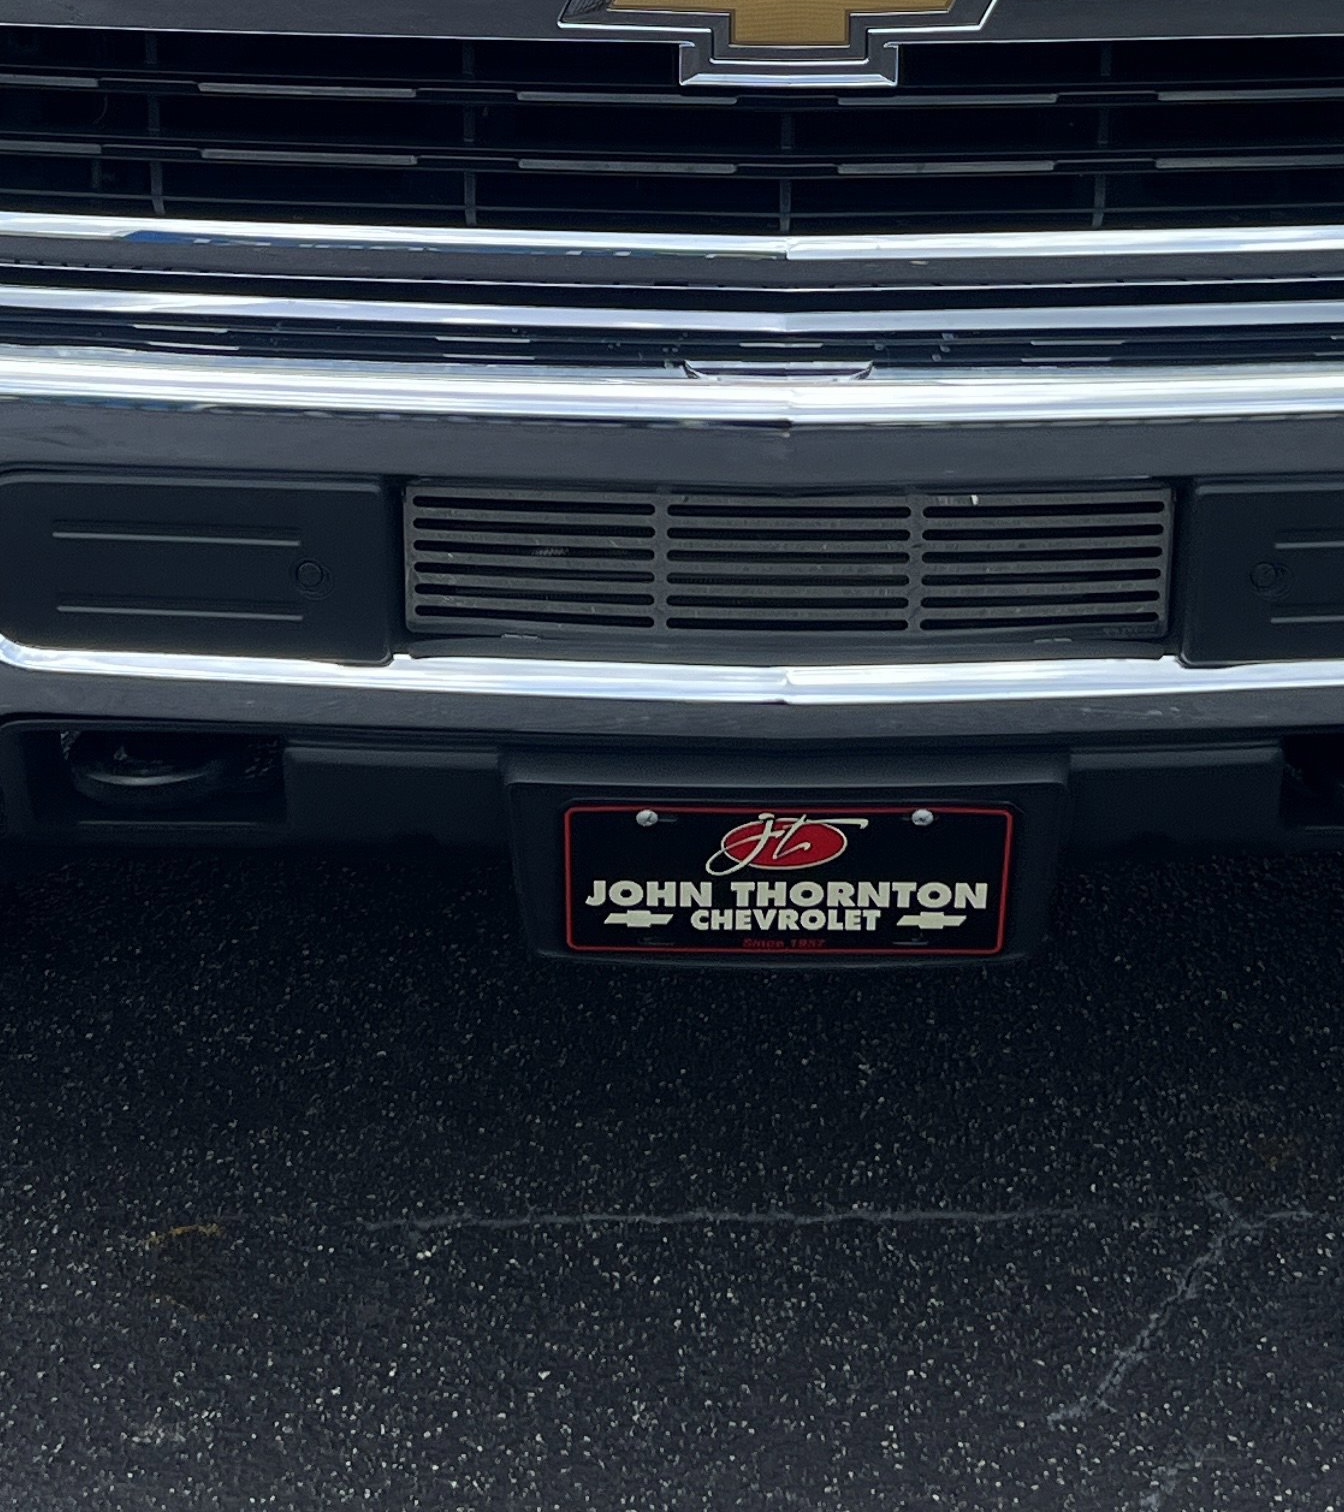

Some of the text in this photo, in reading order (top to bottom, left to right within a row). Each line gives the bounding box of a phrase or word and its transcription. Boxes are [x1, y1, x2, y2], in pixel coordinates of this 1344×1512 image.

[584, 879, 988, 911] JOHN THORNTON
[690, 908, 882, 932] CHEVROLET
